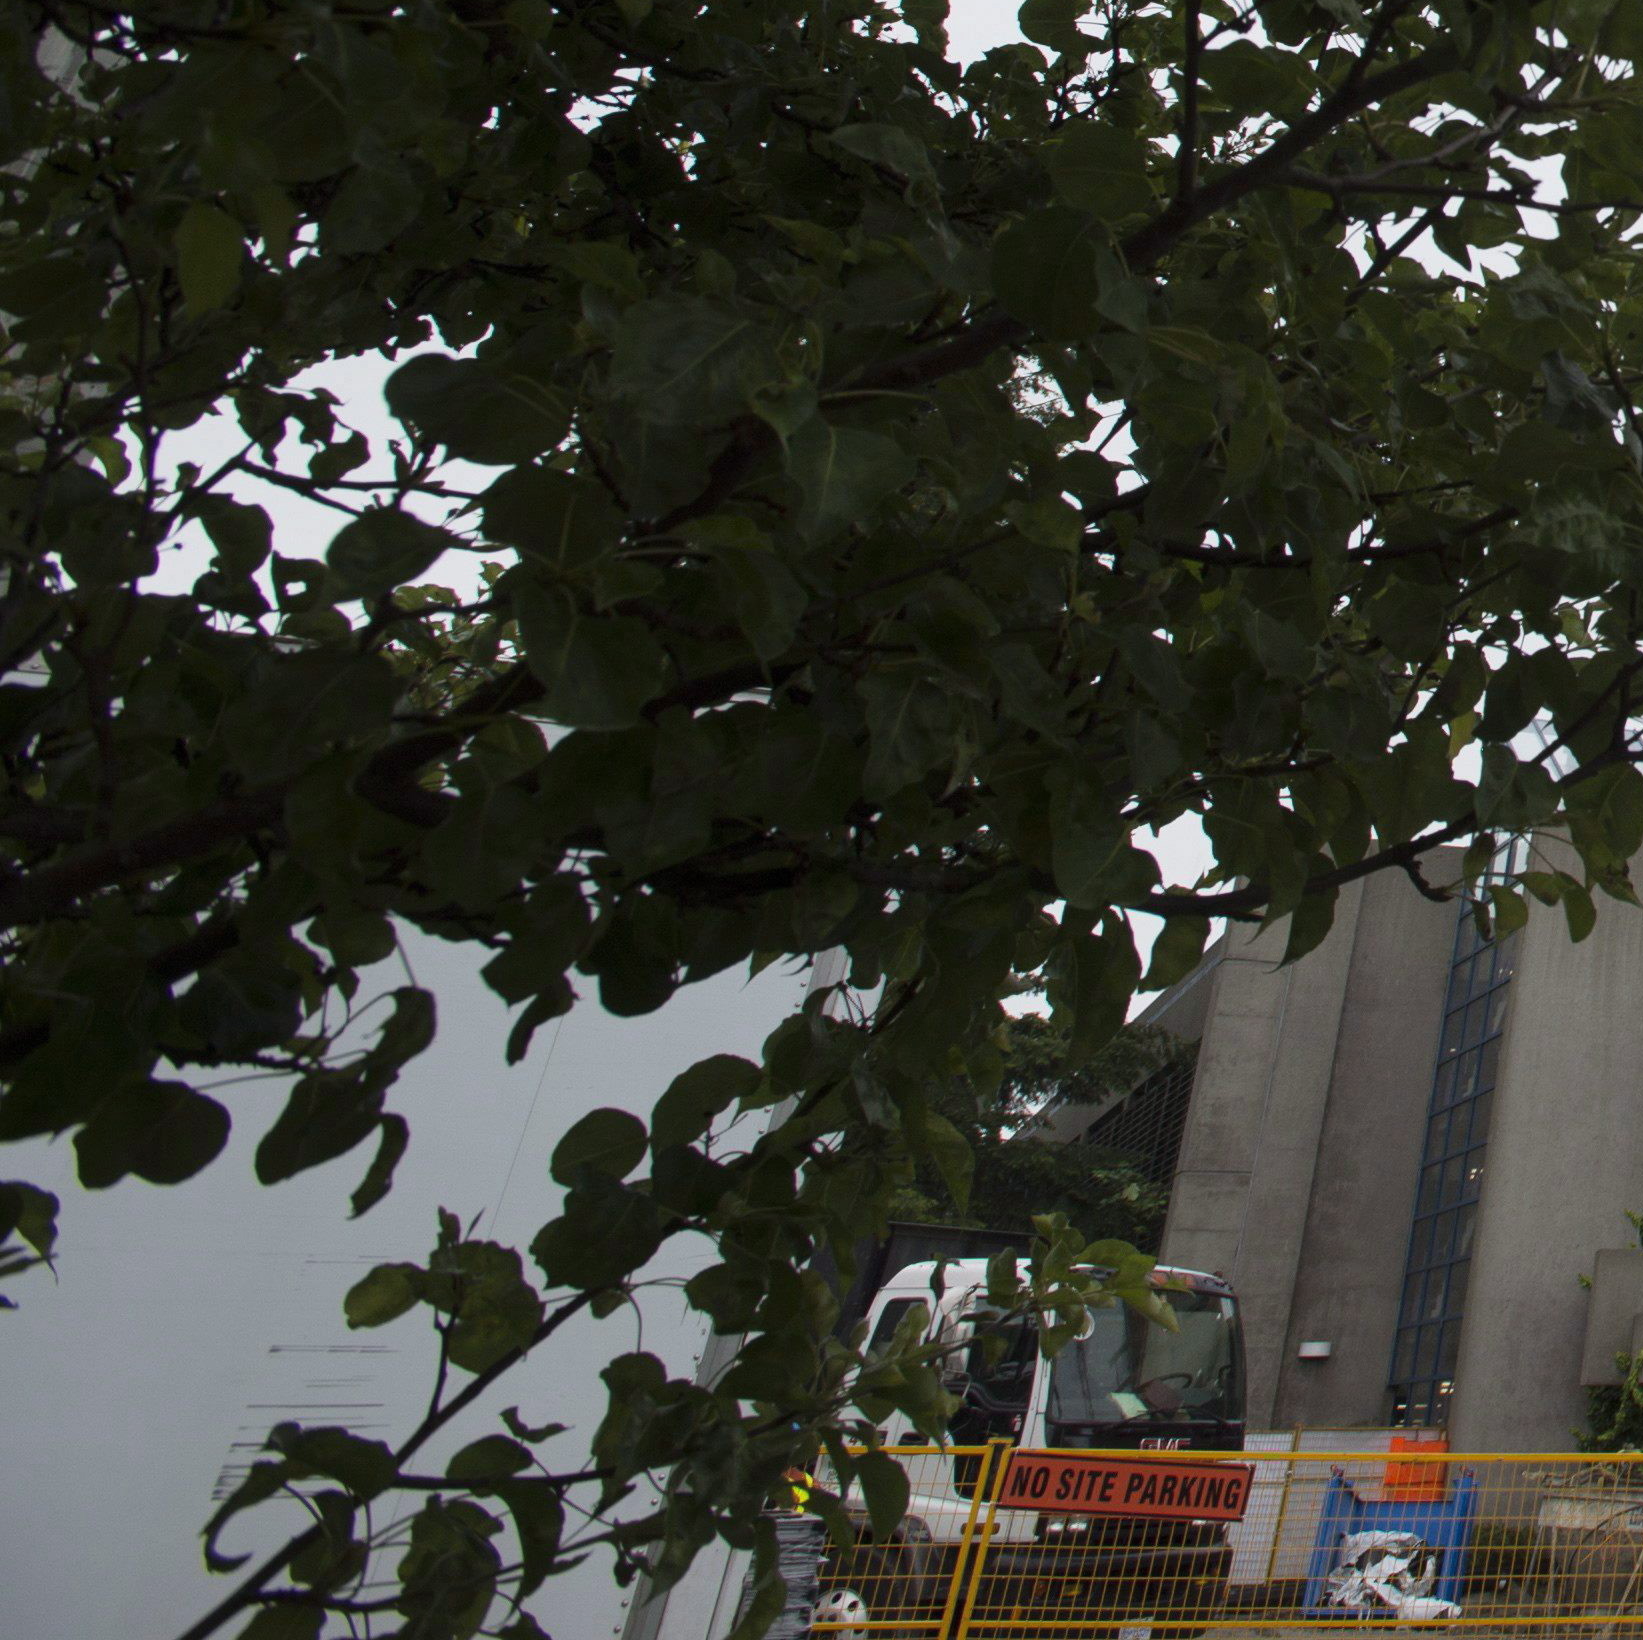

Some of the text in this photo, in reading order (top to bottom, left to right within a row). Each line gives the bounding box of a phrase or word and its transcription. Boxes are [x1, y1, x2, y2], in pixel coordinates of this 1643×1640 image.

[1010, 1466, 1241, 1510] NO SITE PARKING
